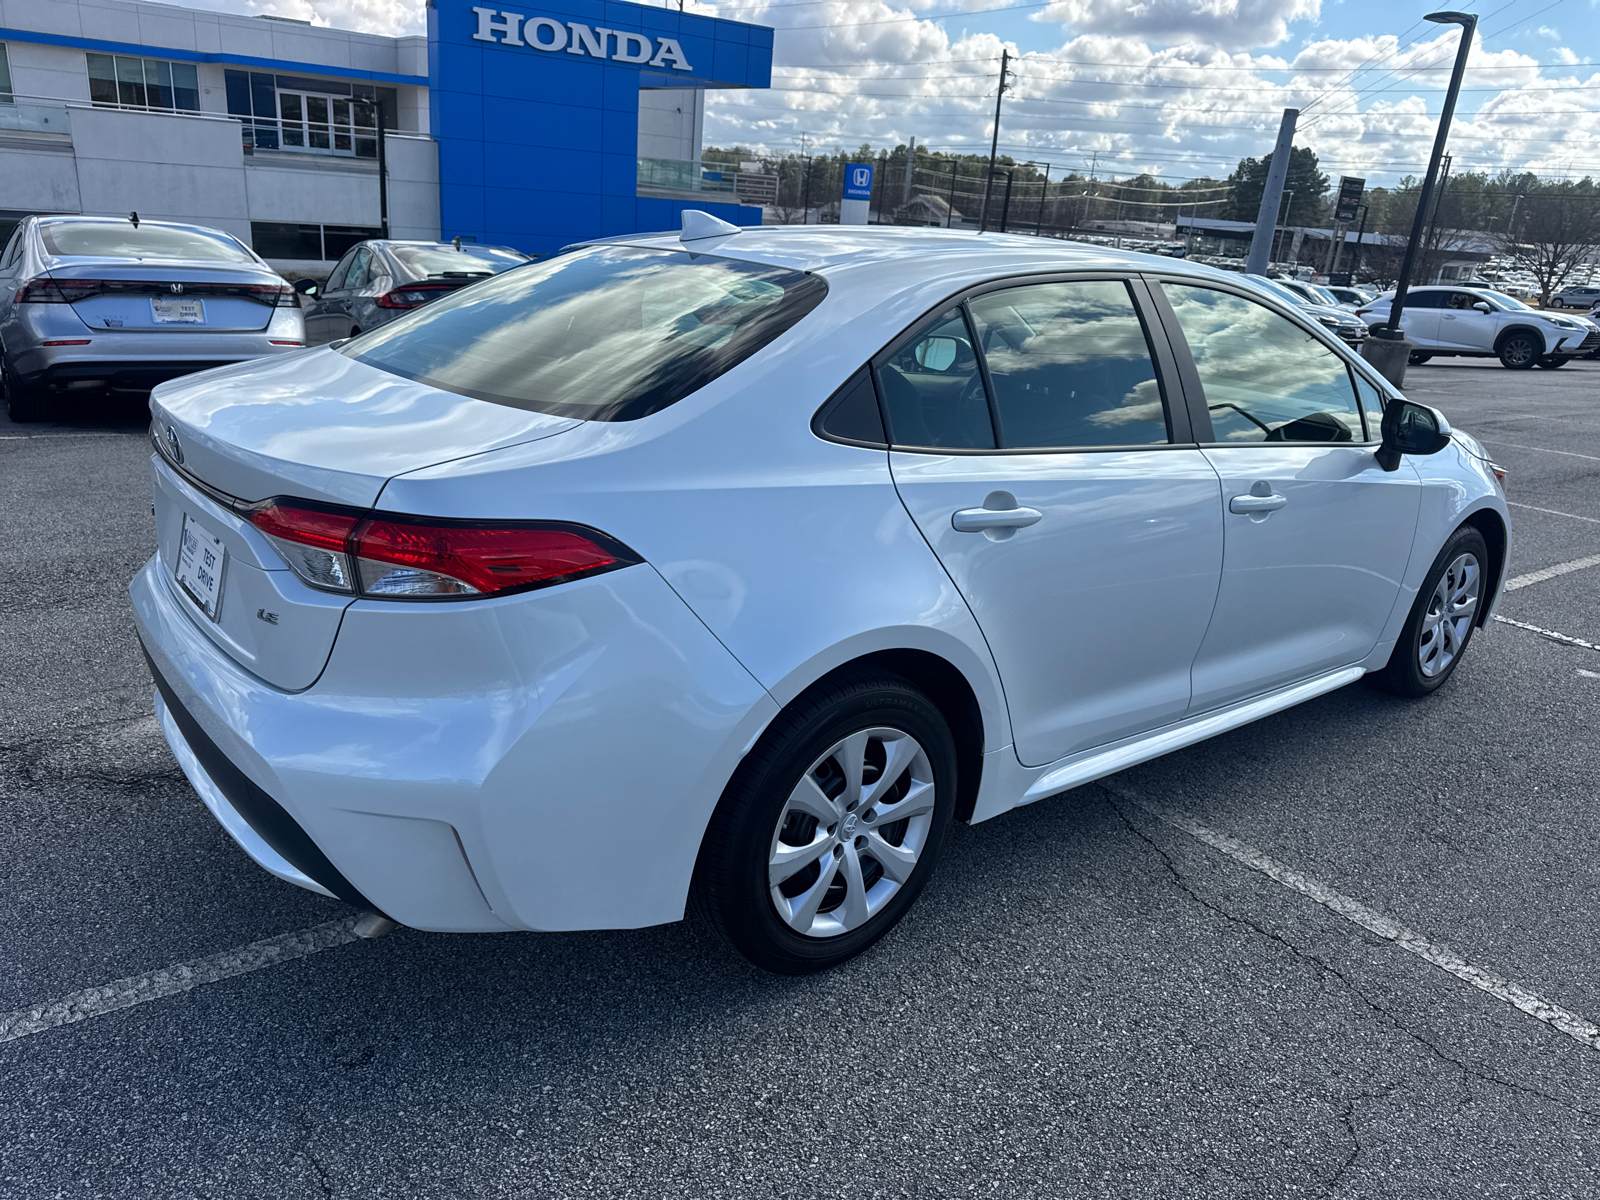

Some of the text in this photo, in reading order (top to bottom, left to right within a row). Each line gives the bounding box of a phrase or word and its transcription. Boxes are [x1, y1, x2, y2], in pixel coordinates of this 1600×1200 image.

[472, 6, 693, 71] HONDA
[203, 547, 216, 570] TEST
[197, 565, 214, 592] DRIVE
[257, 608, 279, 625] LE
